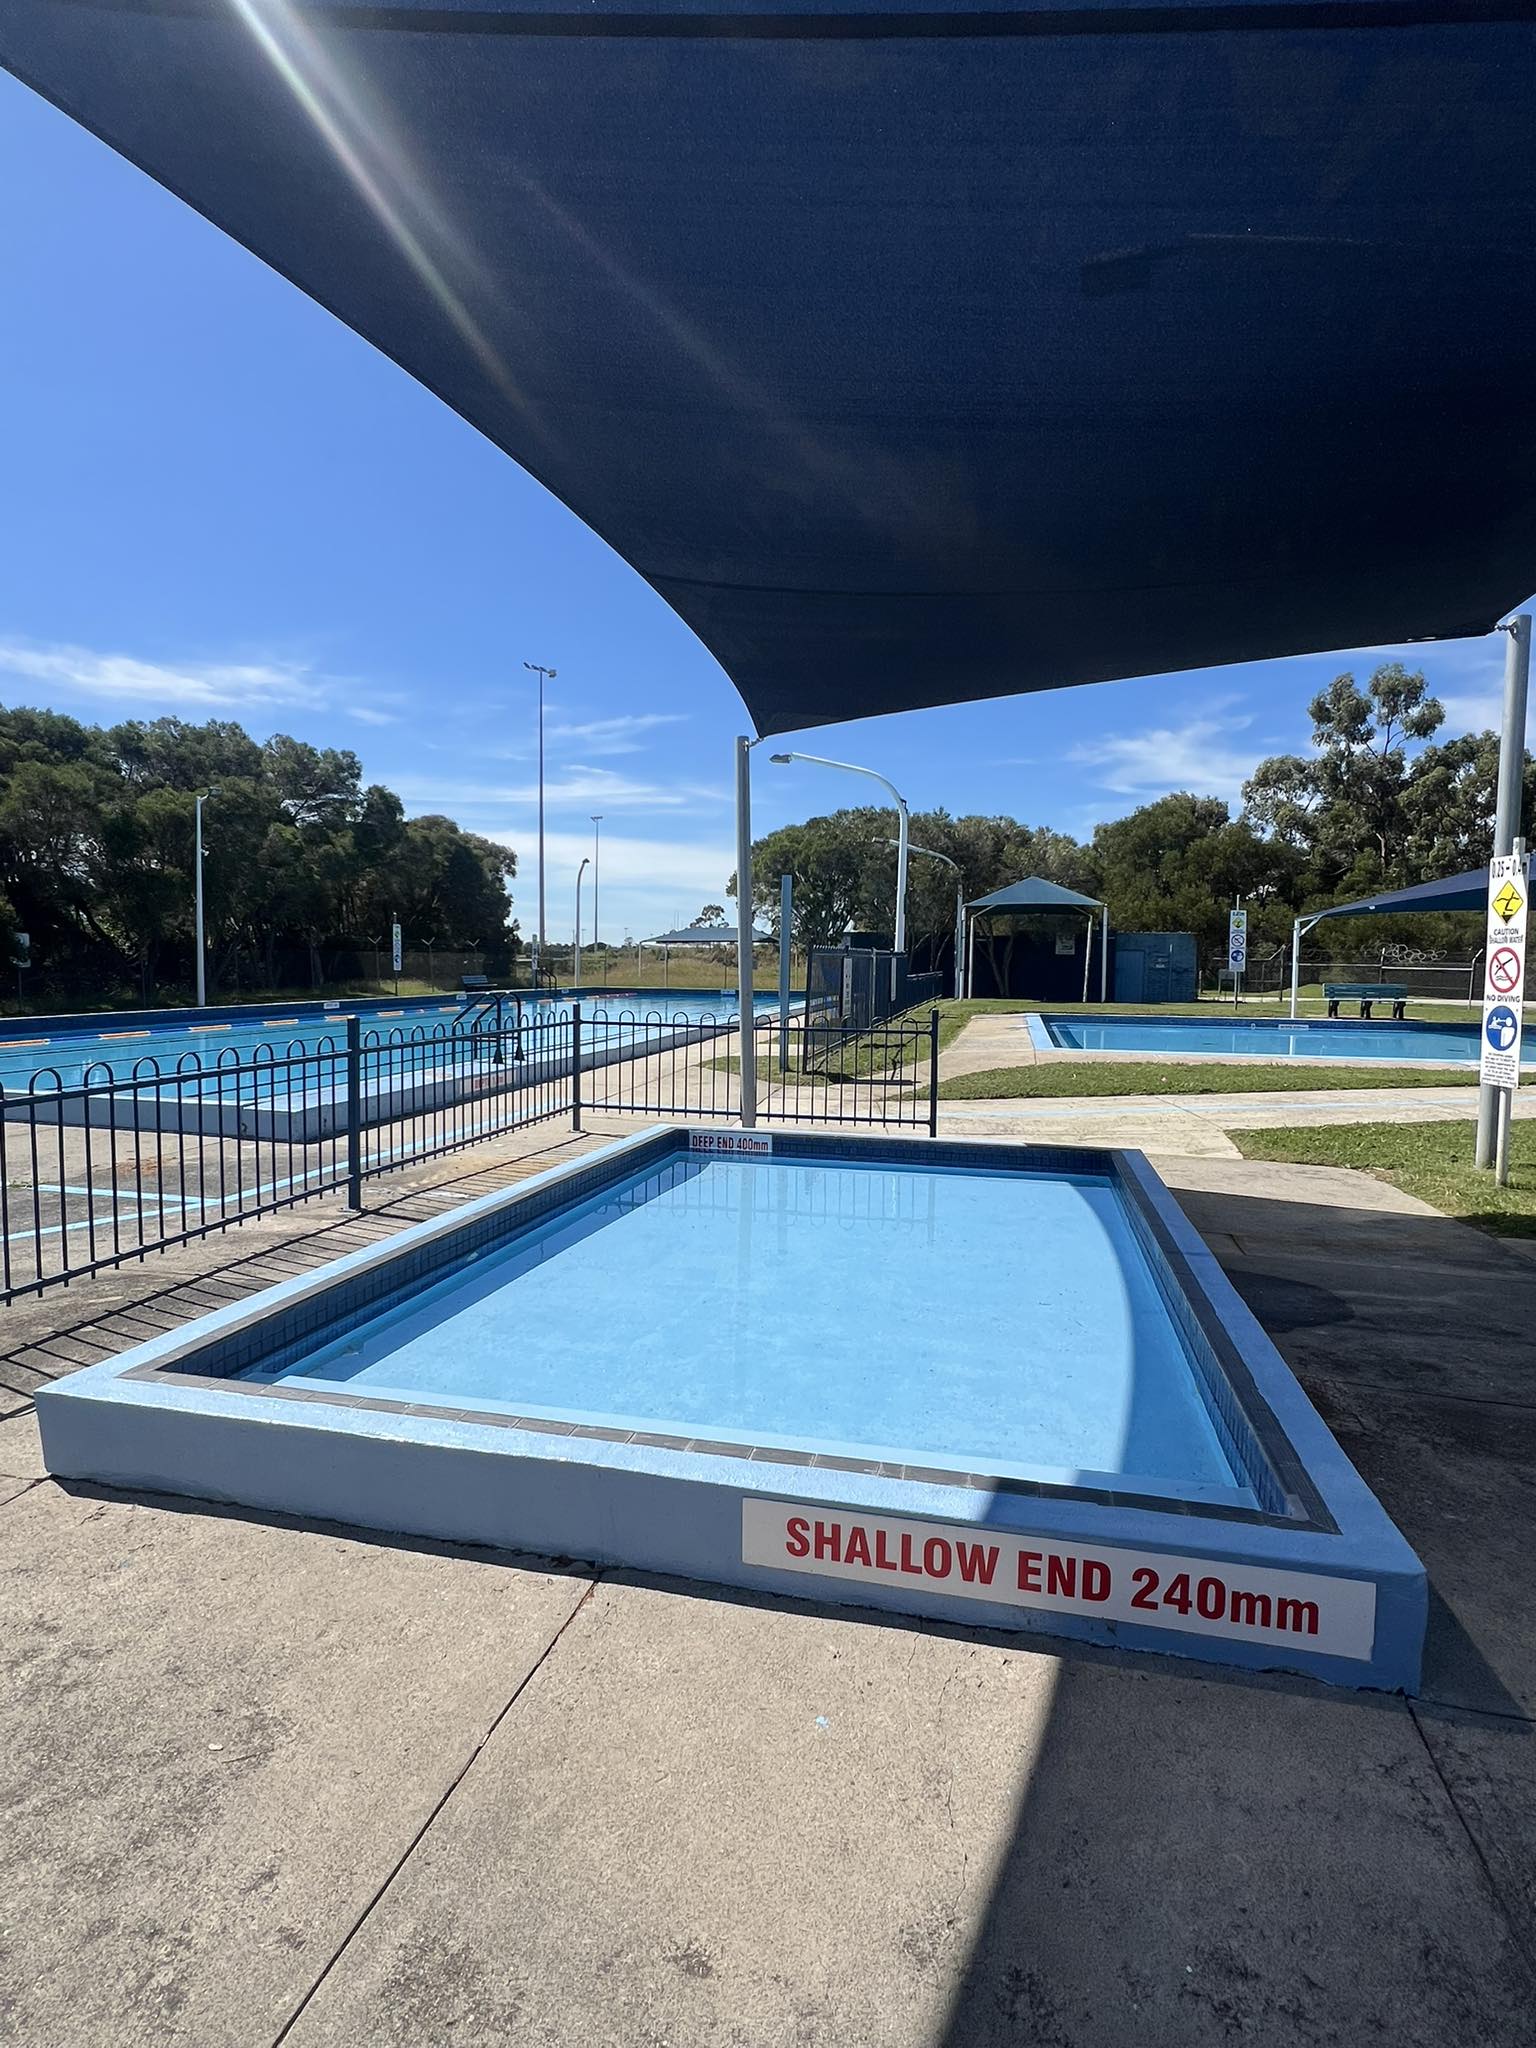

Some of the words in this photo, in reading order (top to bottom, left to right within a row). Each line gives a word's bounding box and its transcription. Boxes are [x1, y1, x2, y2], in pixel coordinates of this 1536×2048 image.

[1493, 928, 1519, 936] CAUTION
[1509, 934, 1524, 944] WATER
[1497, 994, 1520, 1003] DIVING
[692, 1135, 714, 1147] DEEP
[717, 1136, 734, 1149] END
[736, 1137, 769, 1151] 400mm
[785, 1516, 1000, 1585] SHALLOW
[1016, 1550, 1112, 1602] END
[1130, 1568, 1320, 1635] 240mm
